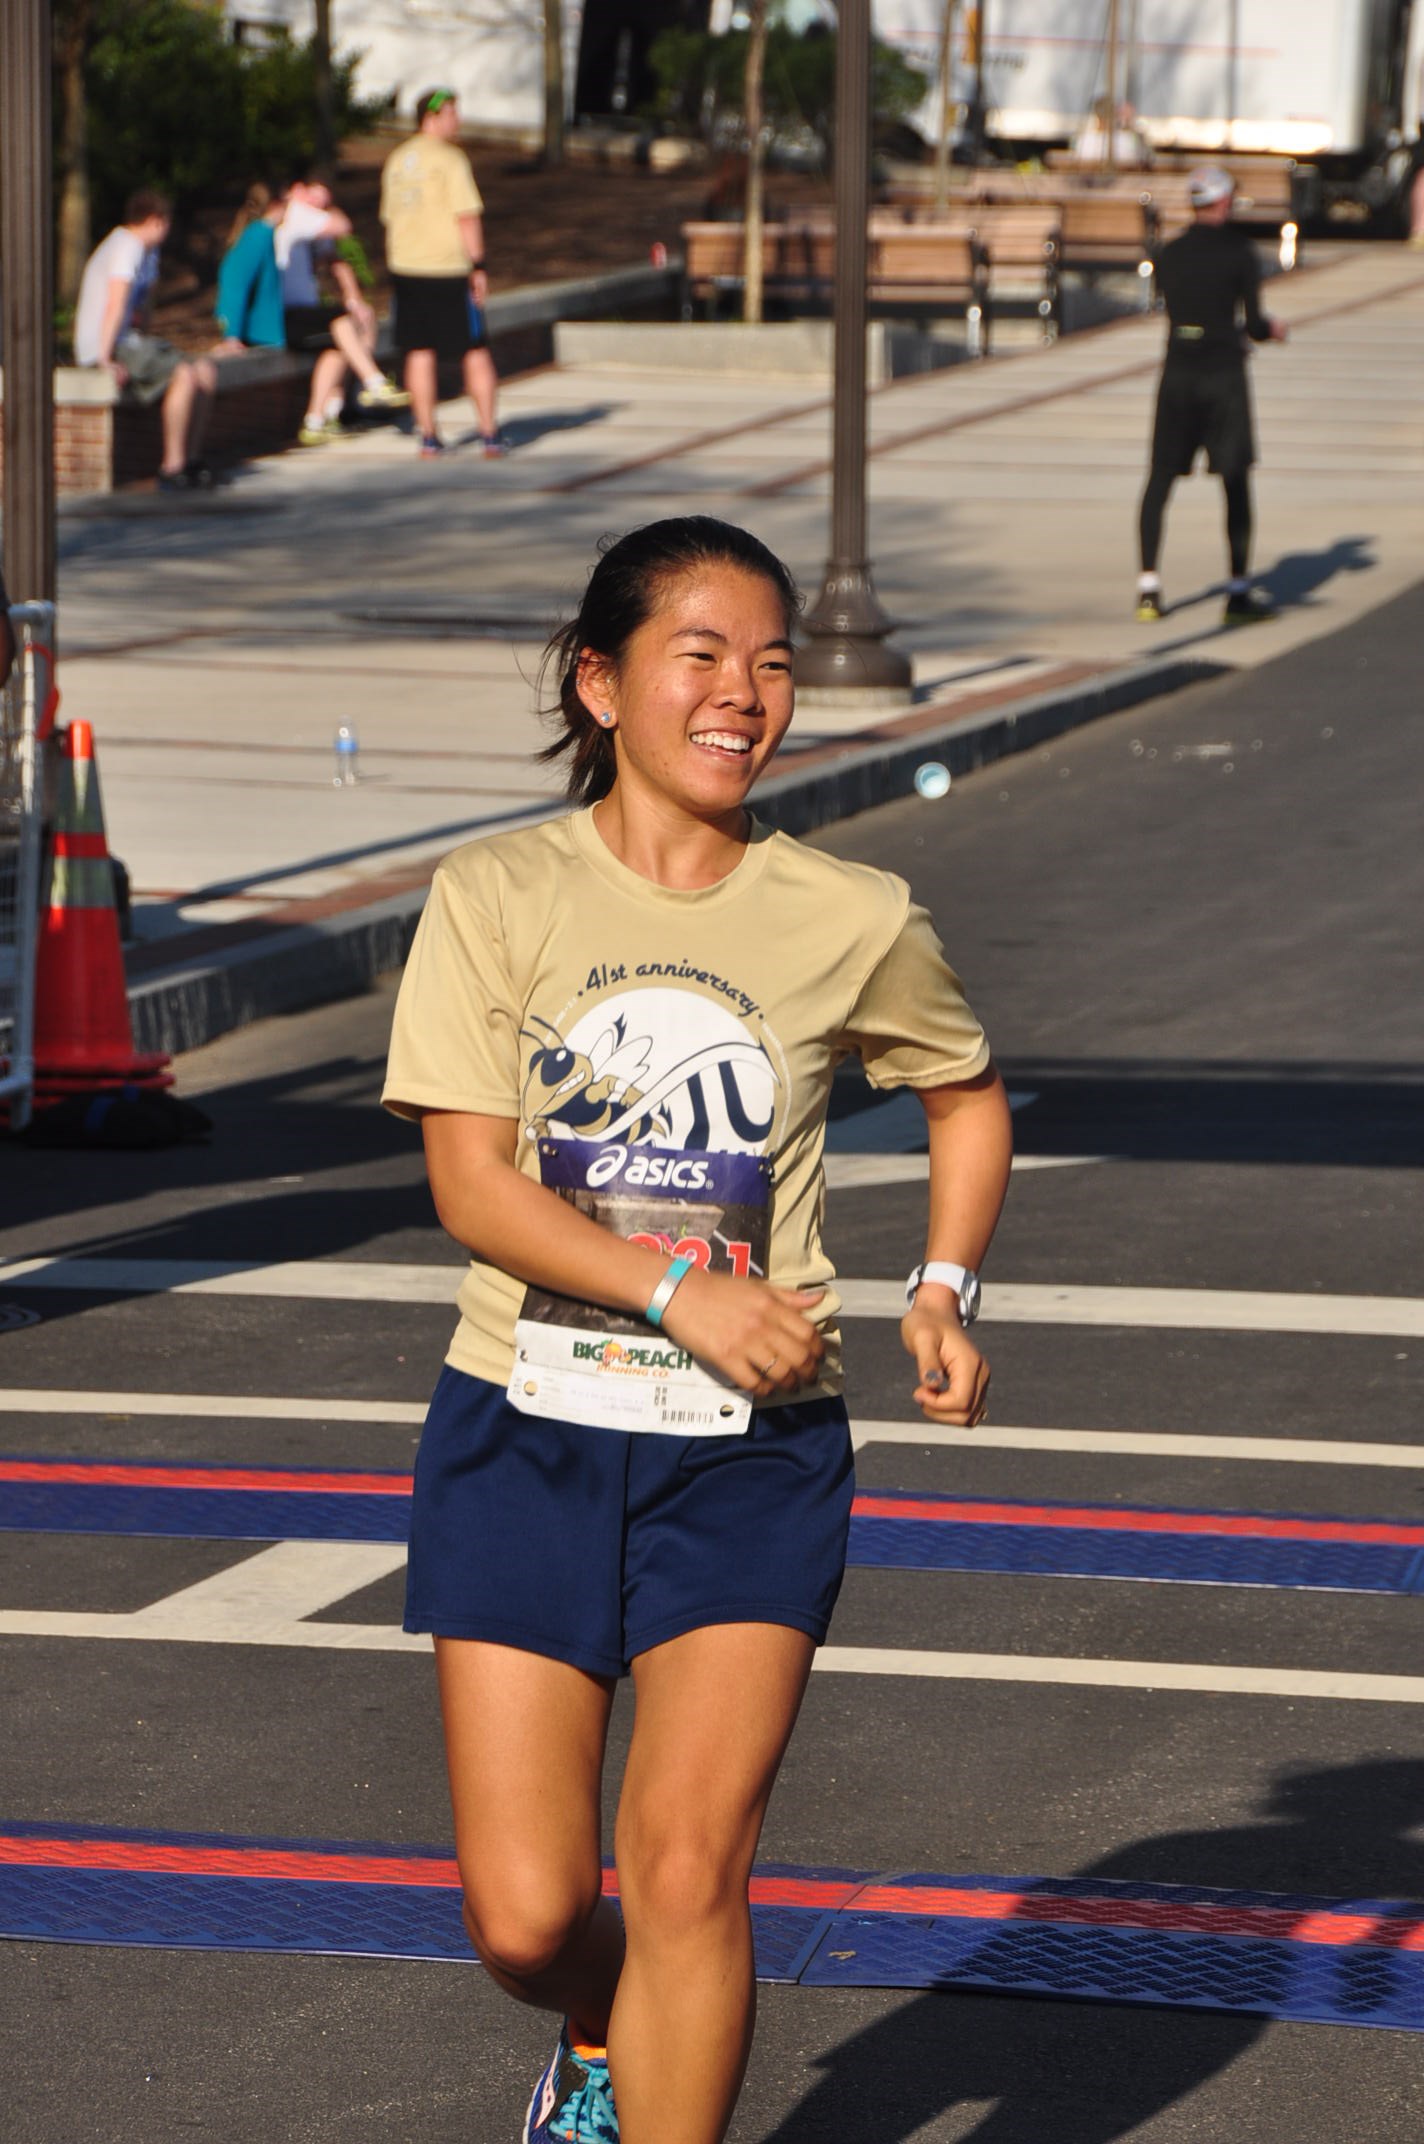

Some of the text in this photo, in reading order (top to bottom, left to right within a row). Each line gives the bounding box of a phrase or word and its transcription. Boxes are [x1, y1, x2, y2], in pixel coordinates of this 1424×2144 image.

[586, 959, 759, 1018] 41st anniversary
[572, 1340, 694, 1371] BIG PEACH
